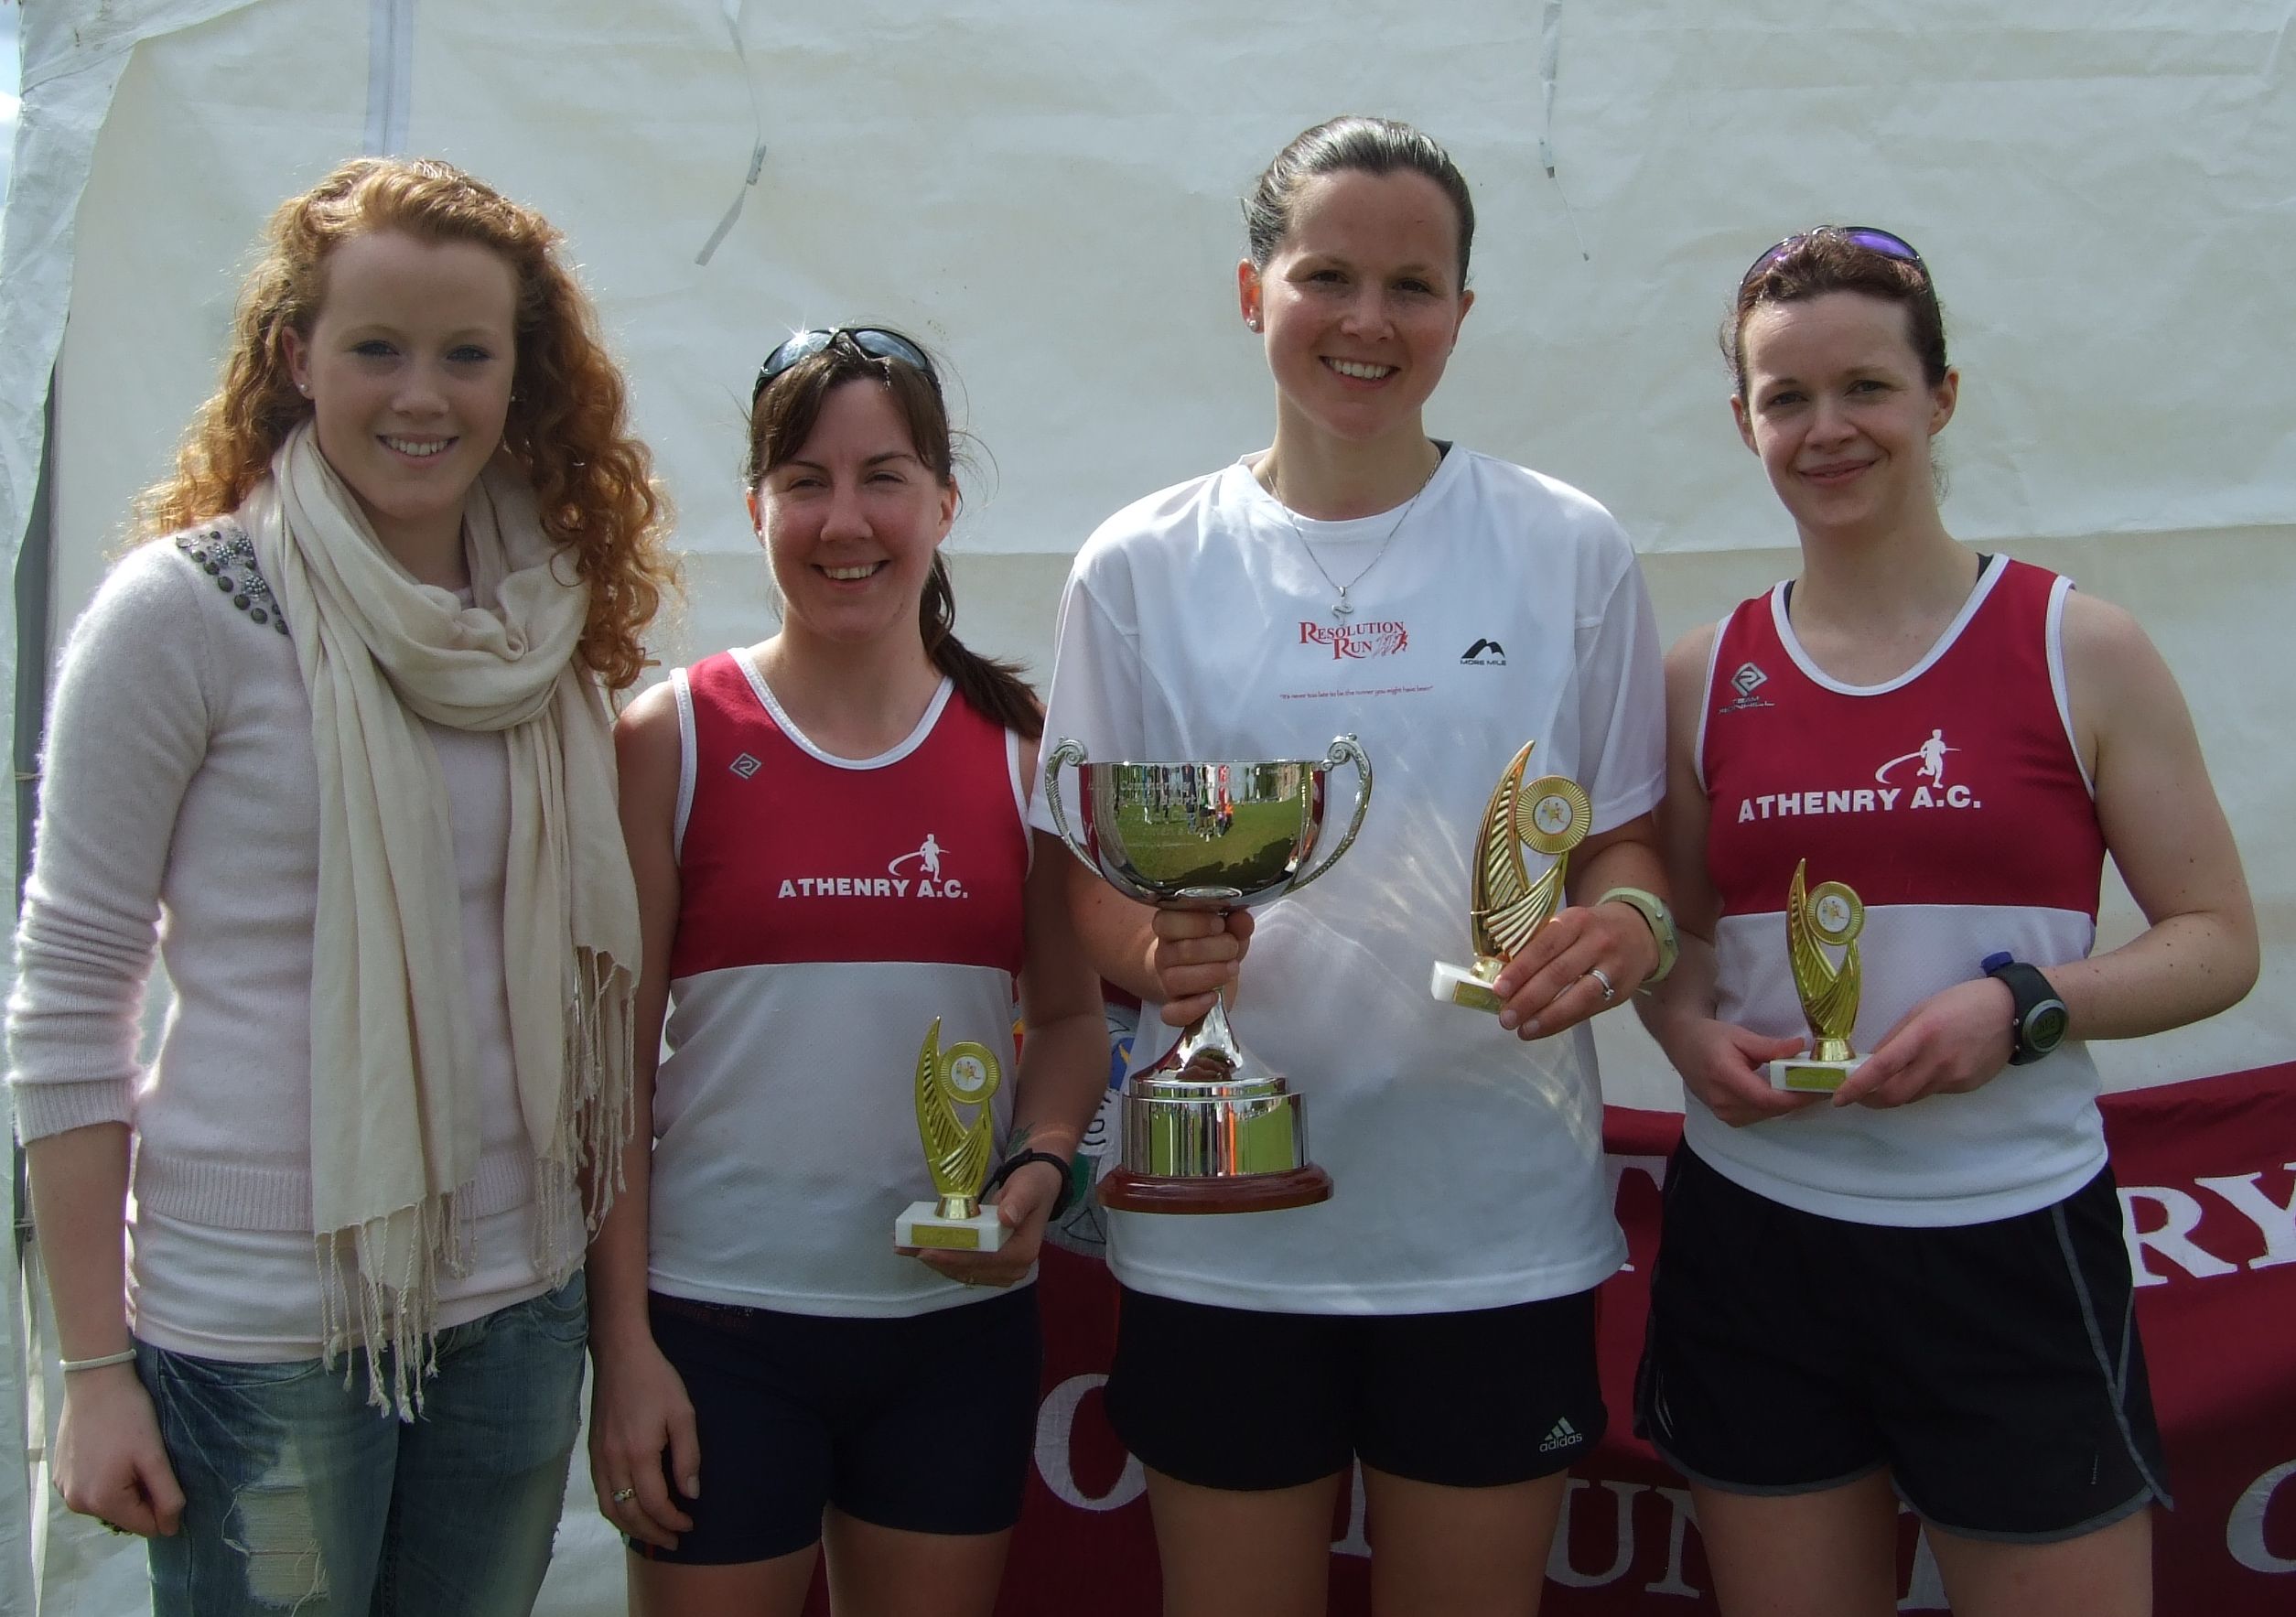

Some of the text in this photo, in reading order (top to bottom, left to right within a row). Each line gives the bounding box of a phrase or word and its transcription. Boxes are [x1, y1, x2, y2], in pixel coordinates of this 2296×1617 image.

[1332, 638, 1373, 660] RUN
[1738, 785, 1981, 824] ATHENRY A.C.
[778, 878, 968, 899] ATHENRY A.C.
[1538, 1433, 1583, 1453] adidas
